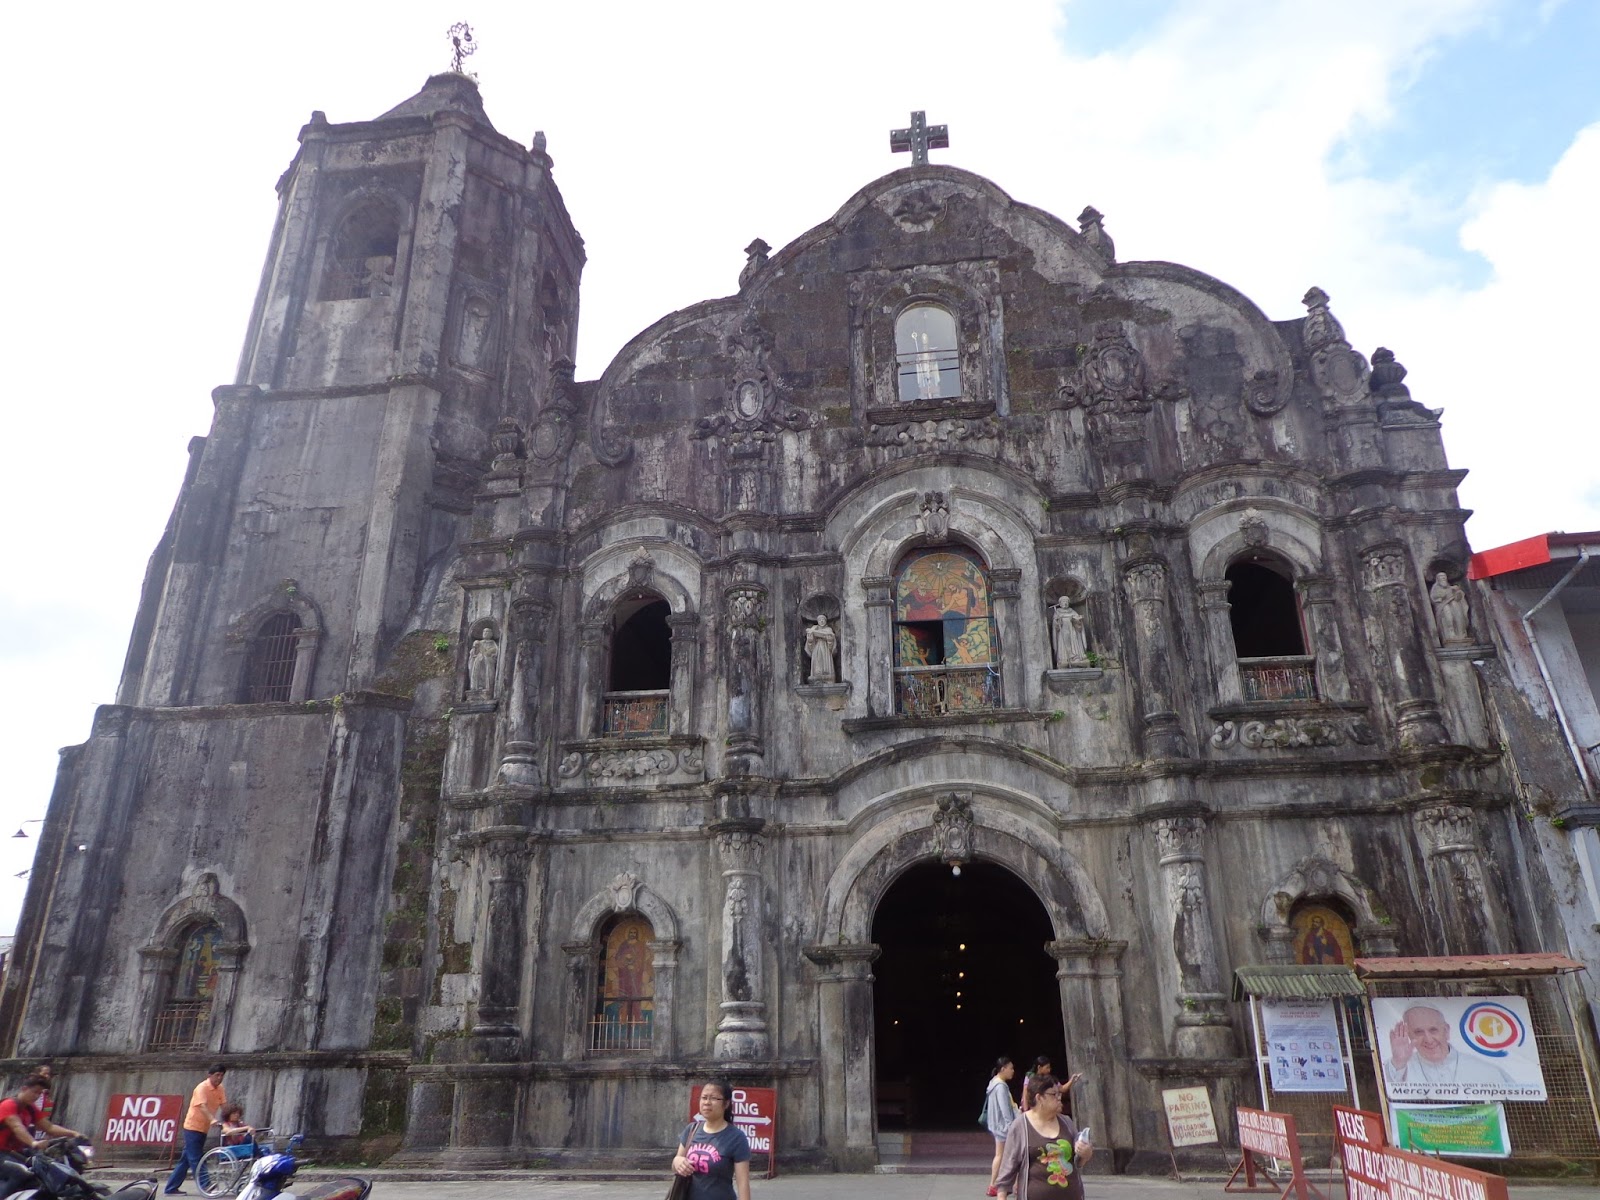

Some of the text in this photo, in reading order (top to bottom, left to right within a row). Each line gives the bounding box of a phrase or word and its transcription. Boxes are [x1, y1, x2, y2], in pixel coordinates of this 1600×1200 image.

[732, 1090, 747, 1102] O
[1179, 1093, 1194, 1102] NO
[1392, 1087, 1541, 1096] Mercy and Compassion
[121, 1096, 162, 1118] NO
[1168, 1101, 1208, 1113] PARKING
[105, 1118, 176, 1143] PARKING
[1336, 1110, 1369, 1143] PLEASE
[687, 1143, 722, 1163] HALLENGE
